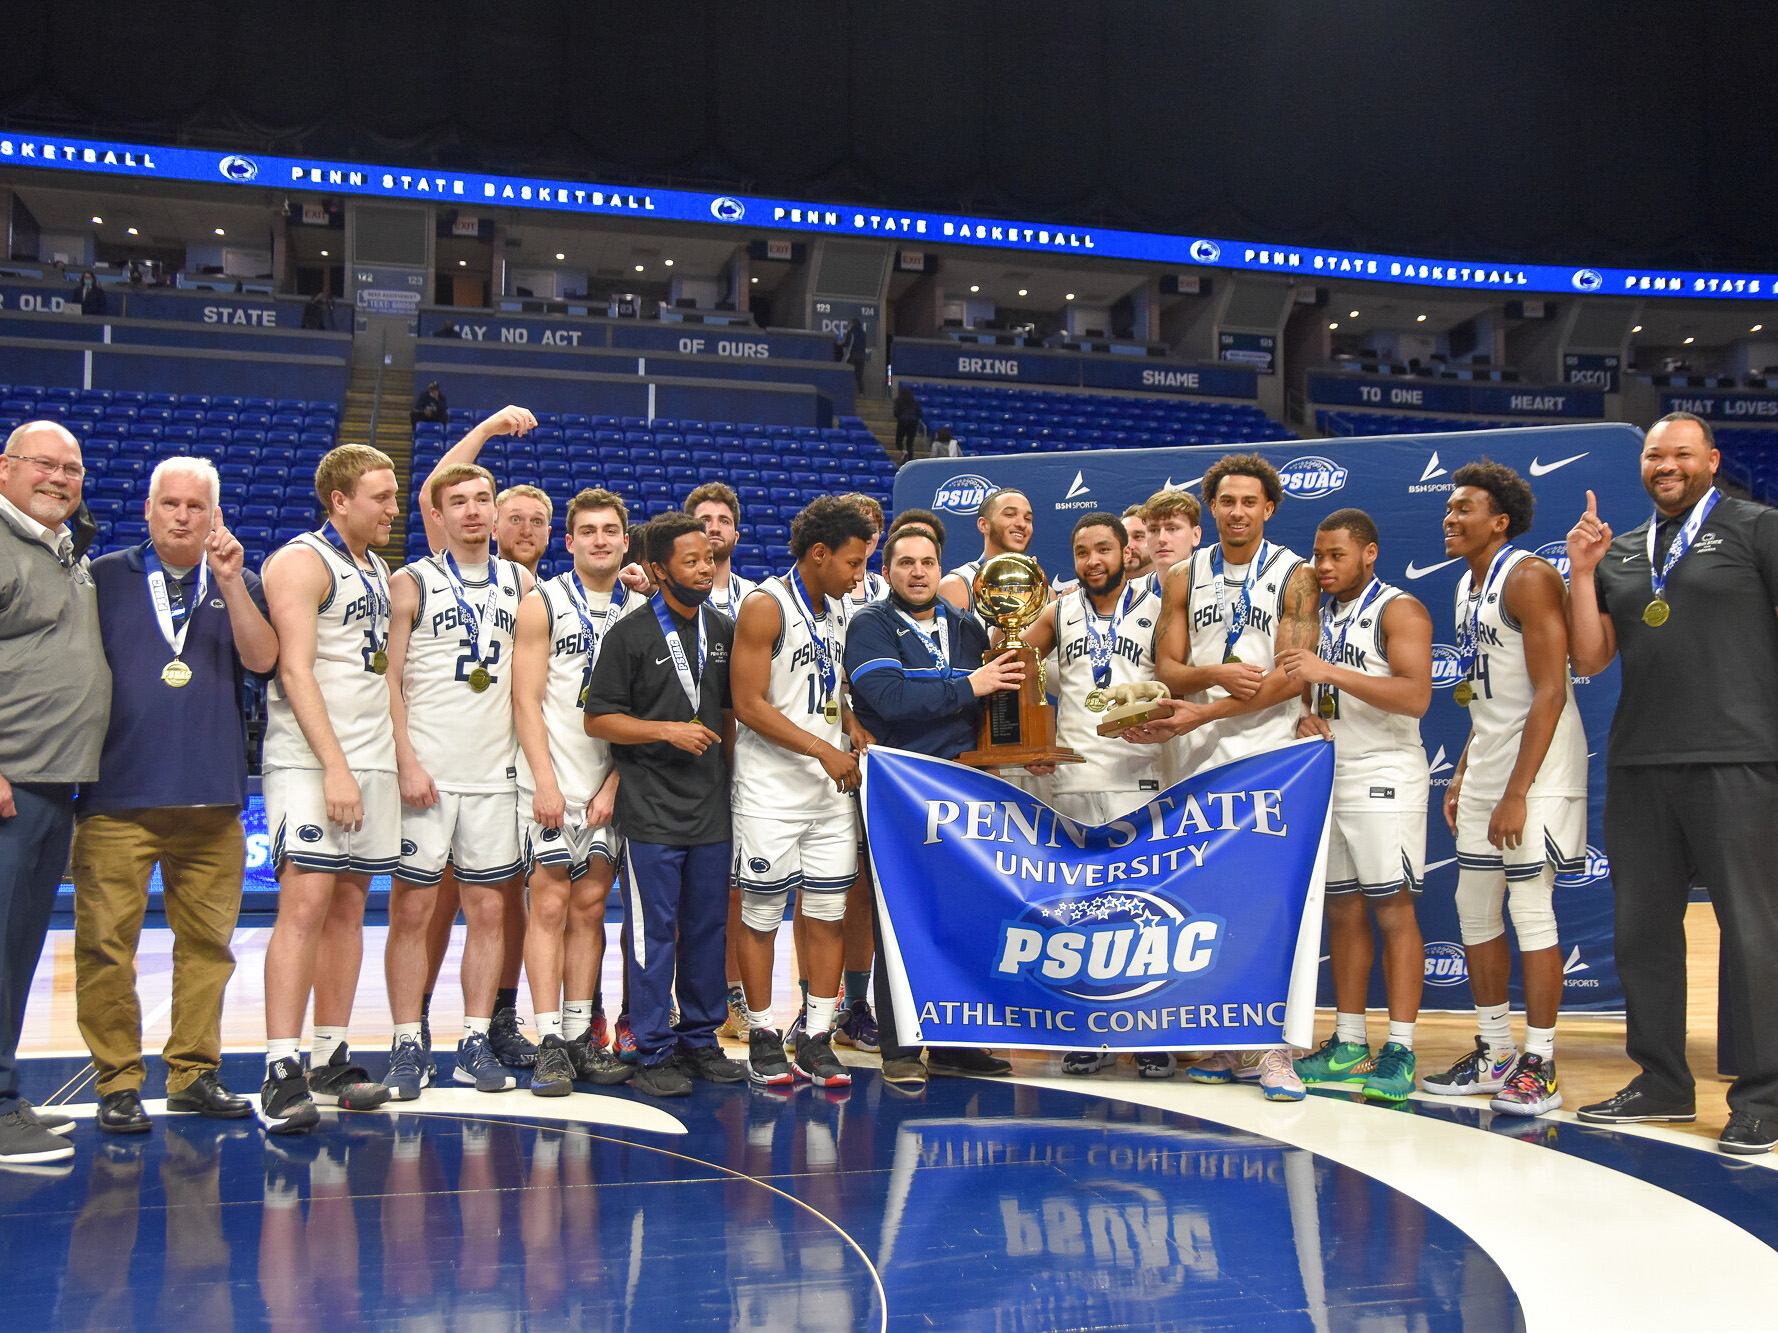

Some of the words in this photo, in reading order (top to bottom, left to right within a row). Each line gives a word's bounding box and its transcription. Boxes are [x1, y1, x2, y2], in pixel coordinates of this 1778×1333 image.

[0, 140, 156, 169] SKETBALL
[291, 166, 362, 186] PENN
[382, 174, 464, 195] STATE
[484, 182, 655, 210] BASKETBALL
[774, 207, 837, 226] PENN
[854, 214, 927, 233] STATE
[943, 222, 1095, 248] BASKETBALL
[769, 243, 789, 254] EXIT
[902, 254, 922, 265] EXIT
[1244, 249, 1300, 266] PENN
[1313, 255, 1378, 274] STATE
[1390, 262, 1528, 285] BASKETBALL
[1625, 275, 1681, 290] PENN
[1693, 277, 1760, 294] STATE
[20, 294, 65, 313] OLD
[203, 306, 276, 327] STATE
[453, 324, 487, 341] AY
[501, 327, 528, 344] NO
[541, 329, 582, 347] ACT
[678, 338, 705, 355] OF
[717, 340, 769, 359] OURS
[958, 357, 1018, 375] BRING
[1142, 370, 1199, 388] SHAME
[1360, 386, 1381, 402] TO
[1391, 388, 1423, 405] ONE
[1511, 395, 1566, 411] HEART
[1670, 399, 1714, 414] THAT
[1725, 401, 1778, 416] LOVES
[1279, 470, 1345, 490] PSUAC
[1570, 676, 1591, 685] ORTS
[923, 799, 1087, 849] PENN
[1106, 789, 1289, 849] STATE
[994, 840, 1209, 888] UNIVERSITY
[999, 920, 1218, 980] PSUAC
[1424, 957, 1468, 976] SUA
[918, 1000, 1076, 1033] ATHLETIC
[1086, 1001, 1288, 1034] CONFERENC
